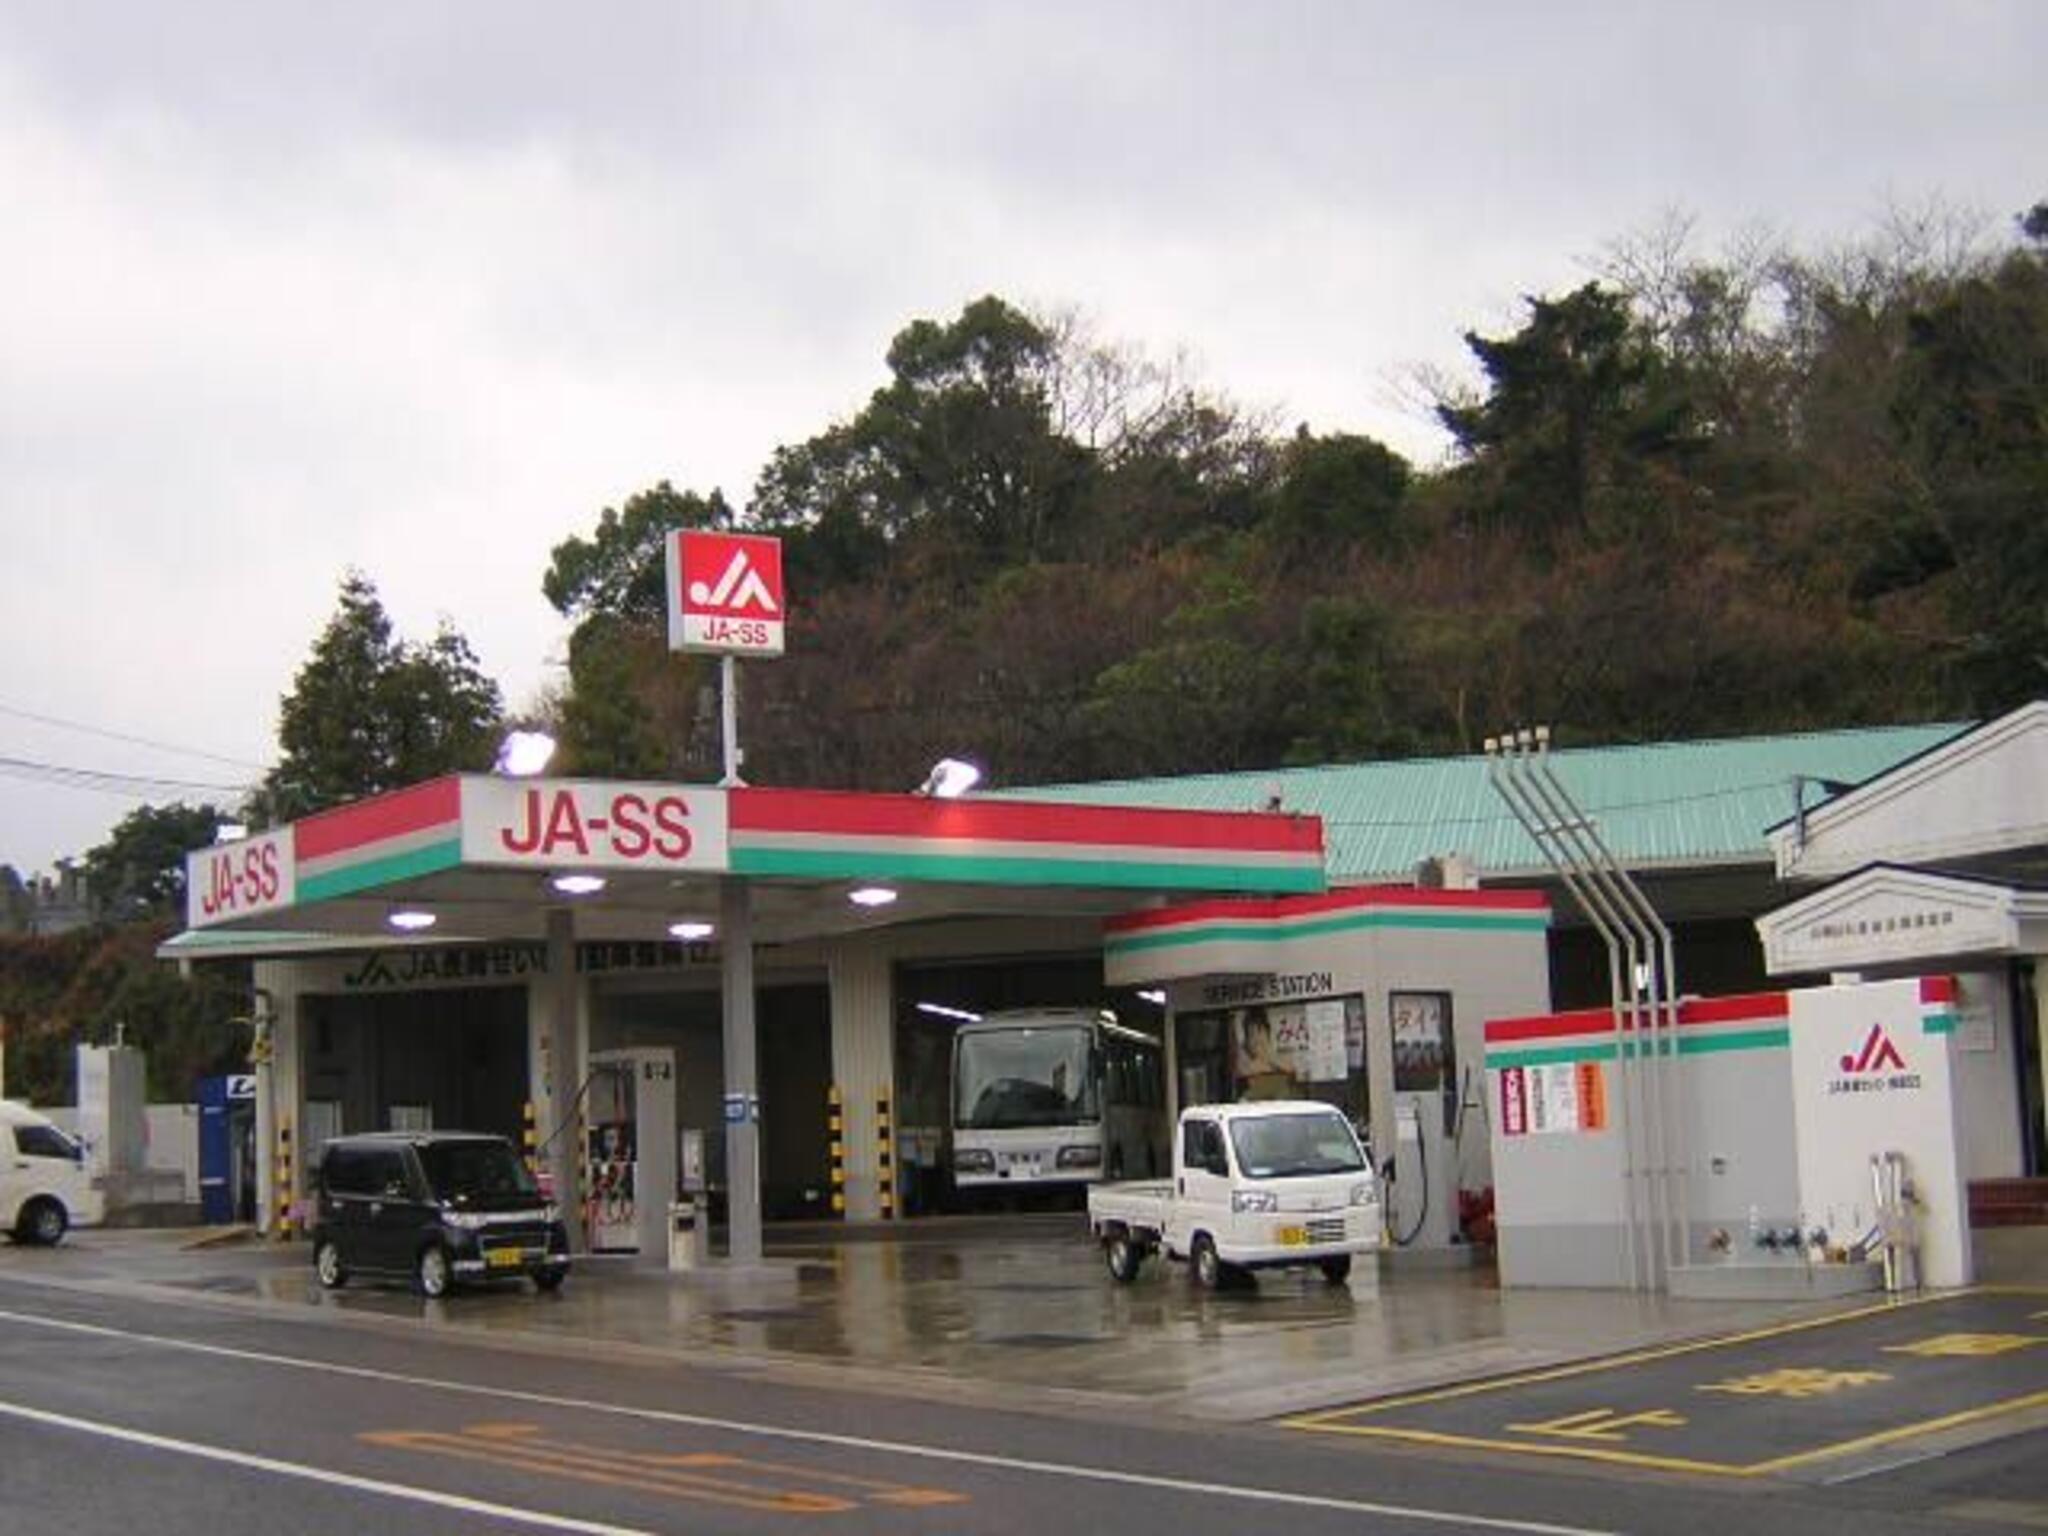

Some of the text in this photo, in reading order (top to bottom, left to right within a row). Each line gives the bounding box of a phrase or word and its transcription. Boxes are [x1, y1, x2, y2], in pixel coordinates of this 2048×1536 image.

[702, 618, 768, 645] JA-SS
[502, 788, 692, 861] JA-SS
[202, 841, 280, 916] JA-SS
[1269, 971, 1333, 998] STATION
